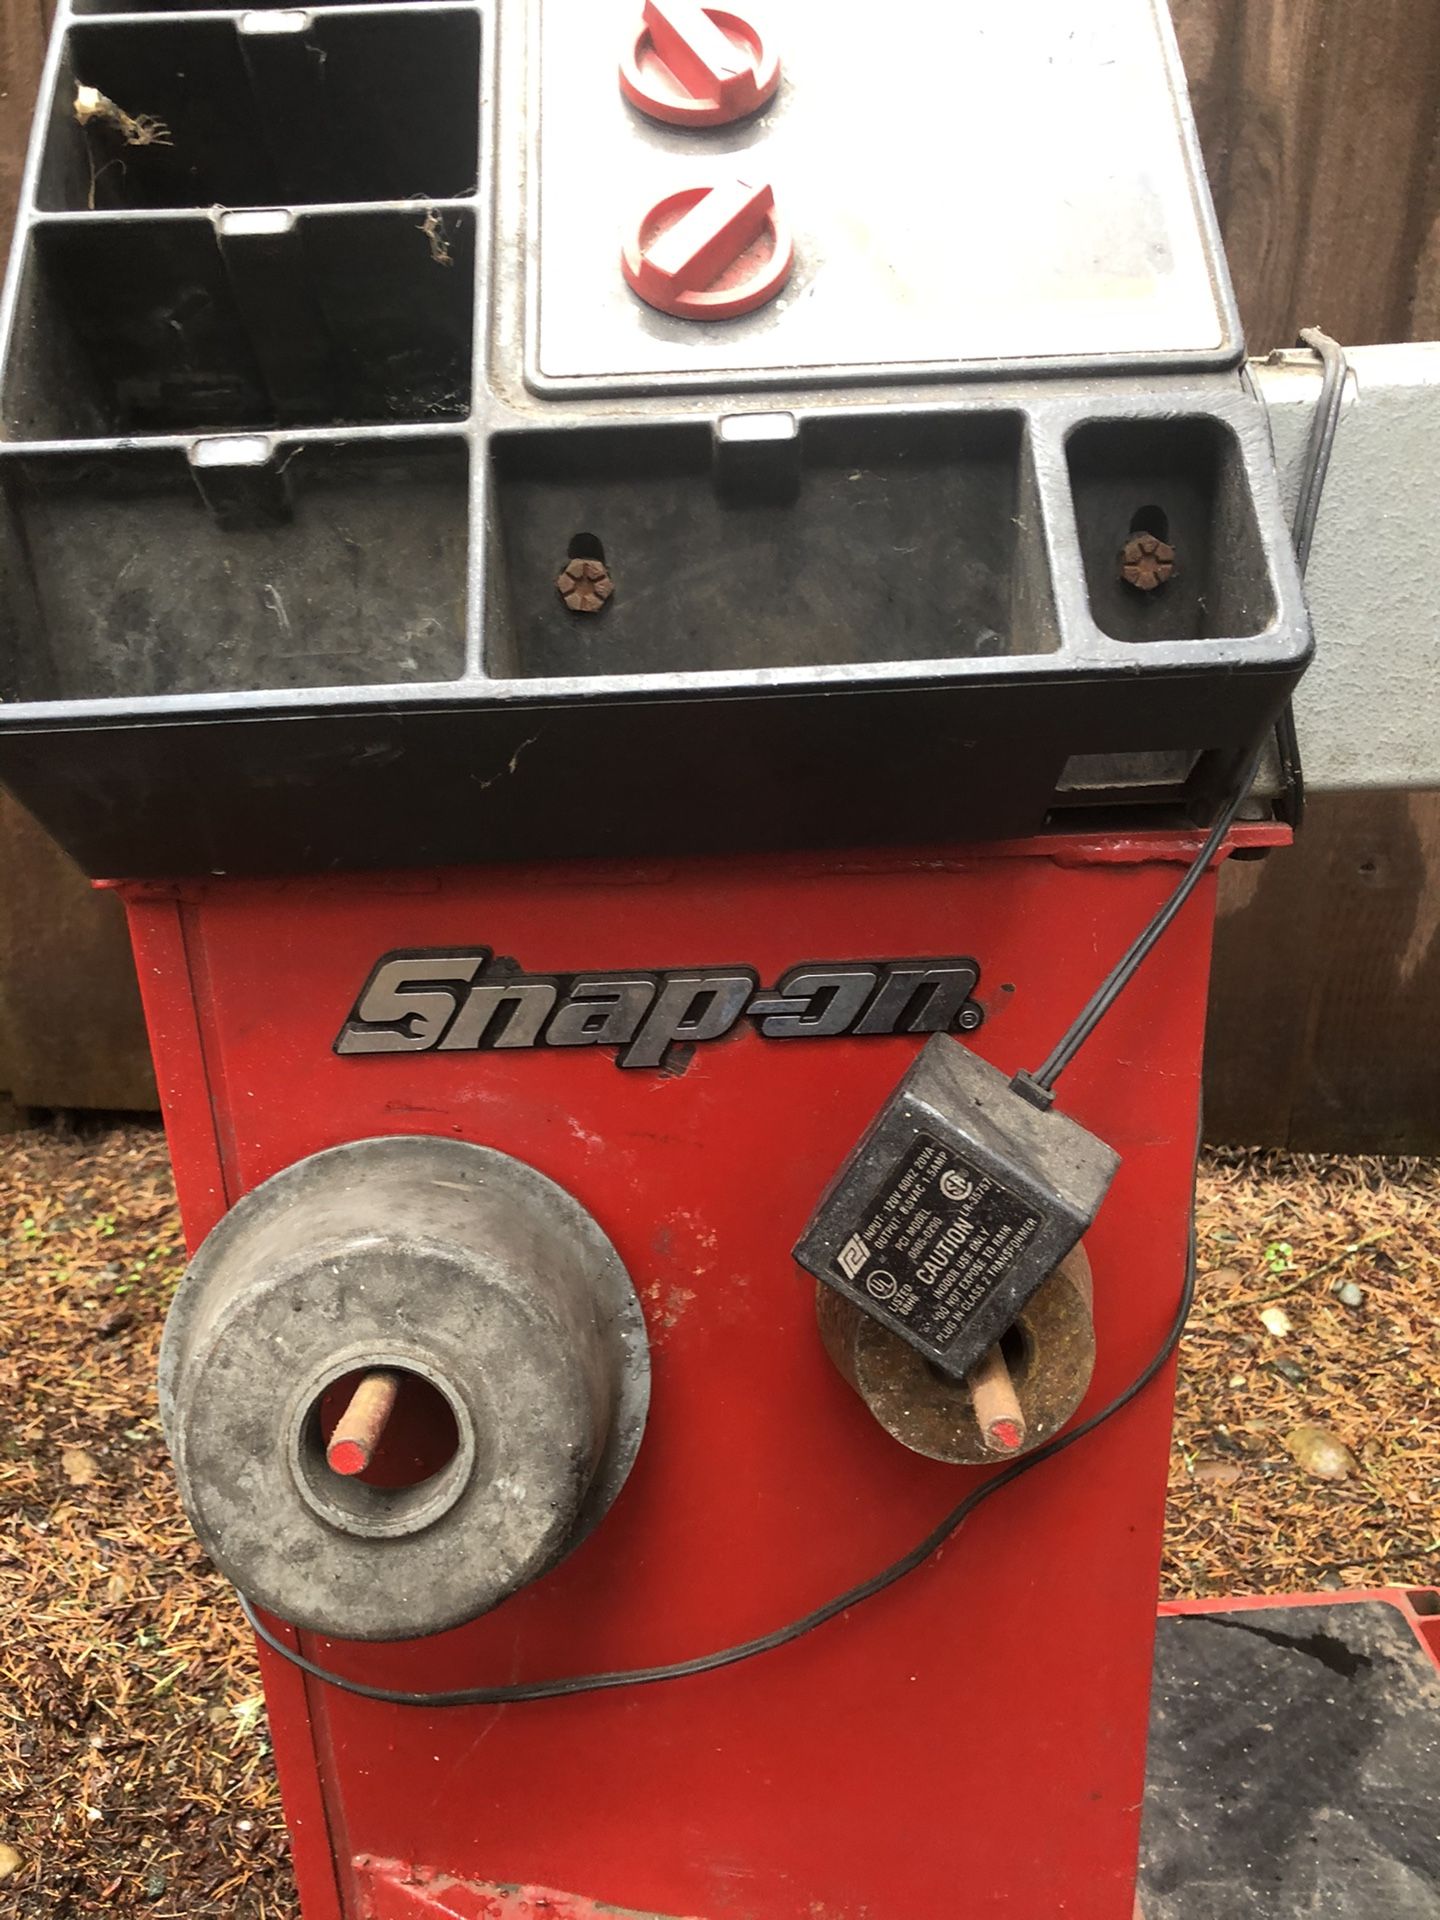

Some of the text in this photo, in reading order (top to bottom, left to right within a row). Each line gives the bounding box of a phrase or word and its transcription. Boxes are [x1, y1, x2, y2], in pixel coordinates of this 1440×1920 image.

[861, 1146, 935, 1241] INPUT: 120V 60HZ 20VA
[873, 1150, 948, 1249] OUTPUT: 8.5VAC 1.5AMP
[894, 1207, 932, 1251] PCI MODEL
[957, 1176, 992, 1217] LR-35757
[907, 1216, 943, 1259] 0505-0290
[915, 1216, 974, 1284] CAUTION
[932, 1225, 990, 1299] INDOOR USE ONLY
[944, 1287, 962, 1307] NOT
[957, 1257, 987, 1290] EXPOSE
[981, 1245, 996, 1259] TO
[991, 1224, 1012, 1247] RAIN
[887, 1283, 913, 1312] LISTED
[935, 1217, 1037, 1343] PLUG IN CLASS 2 TRANSFORMER
